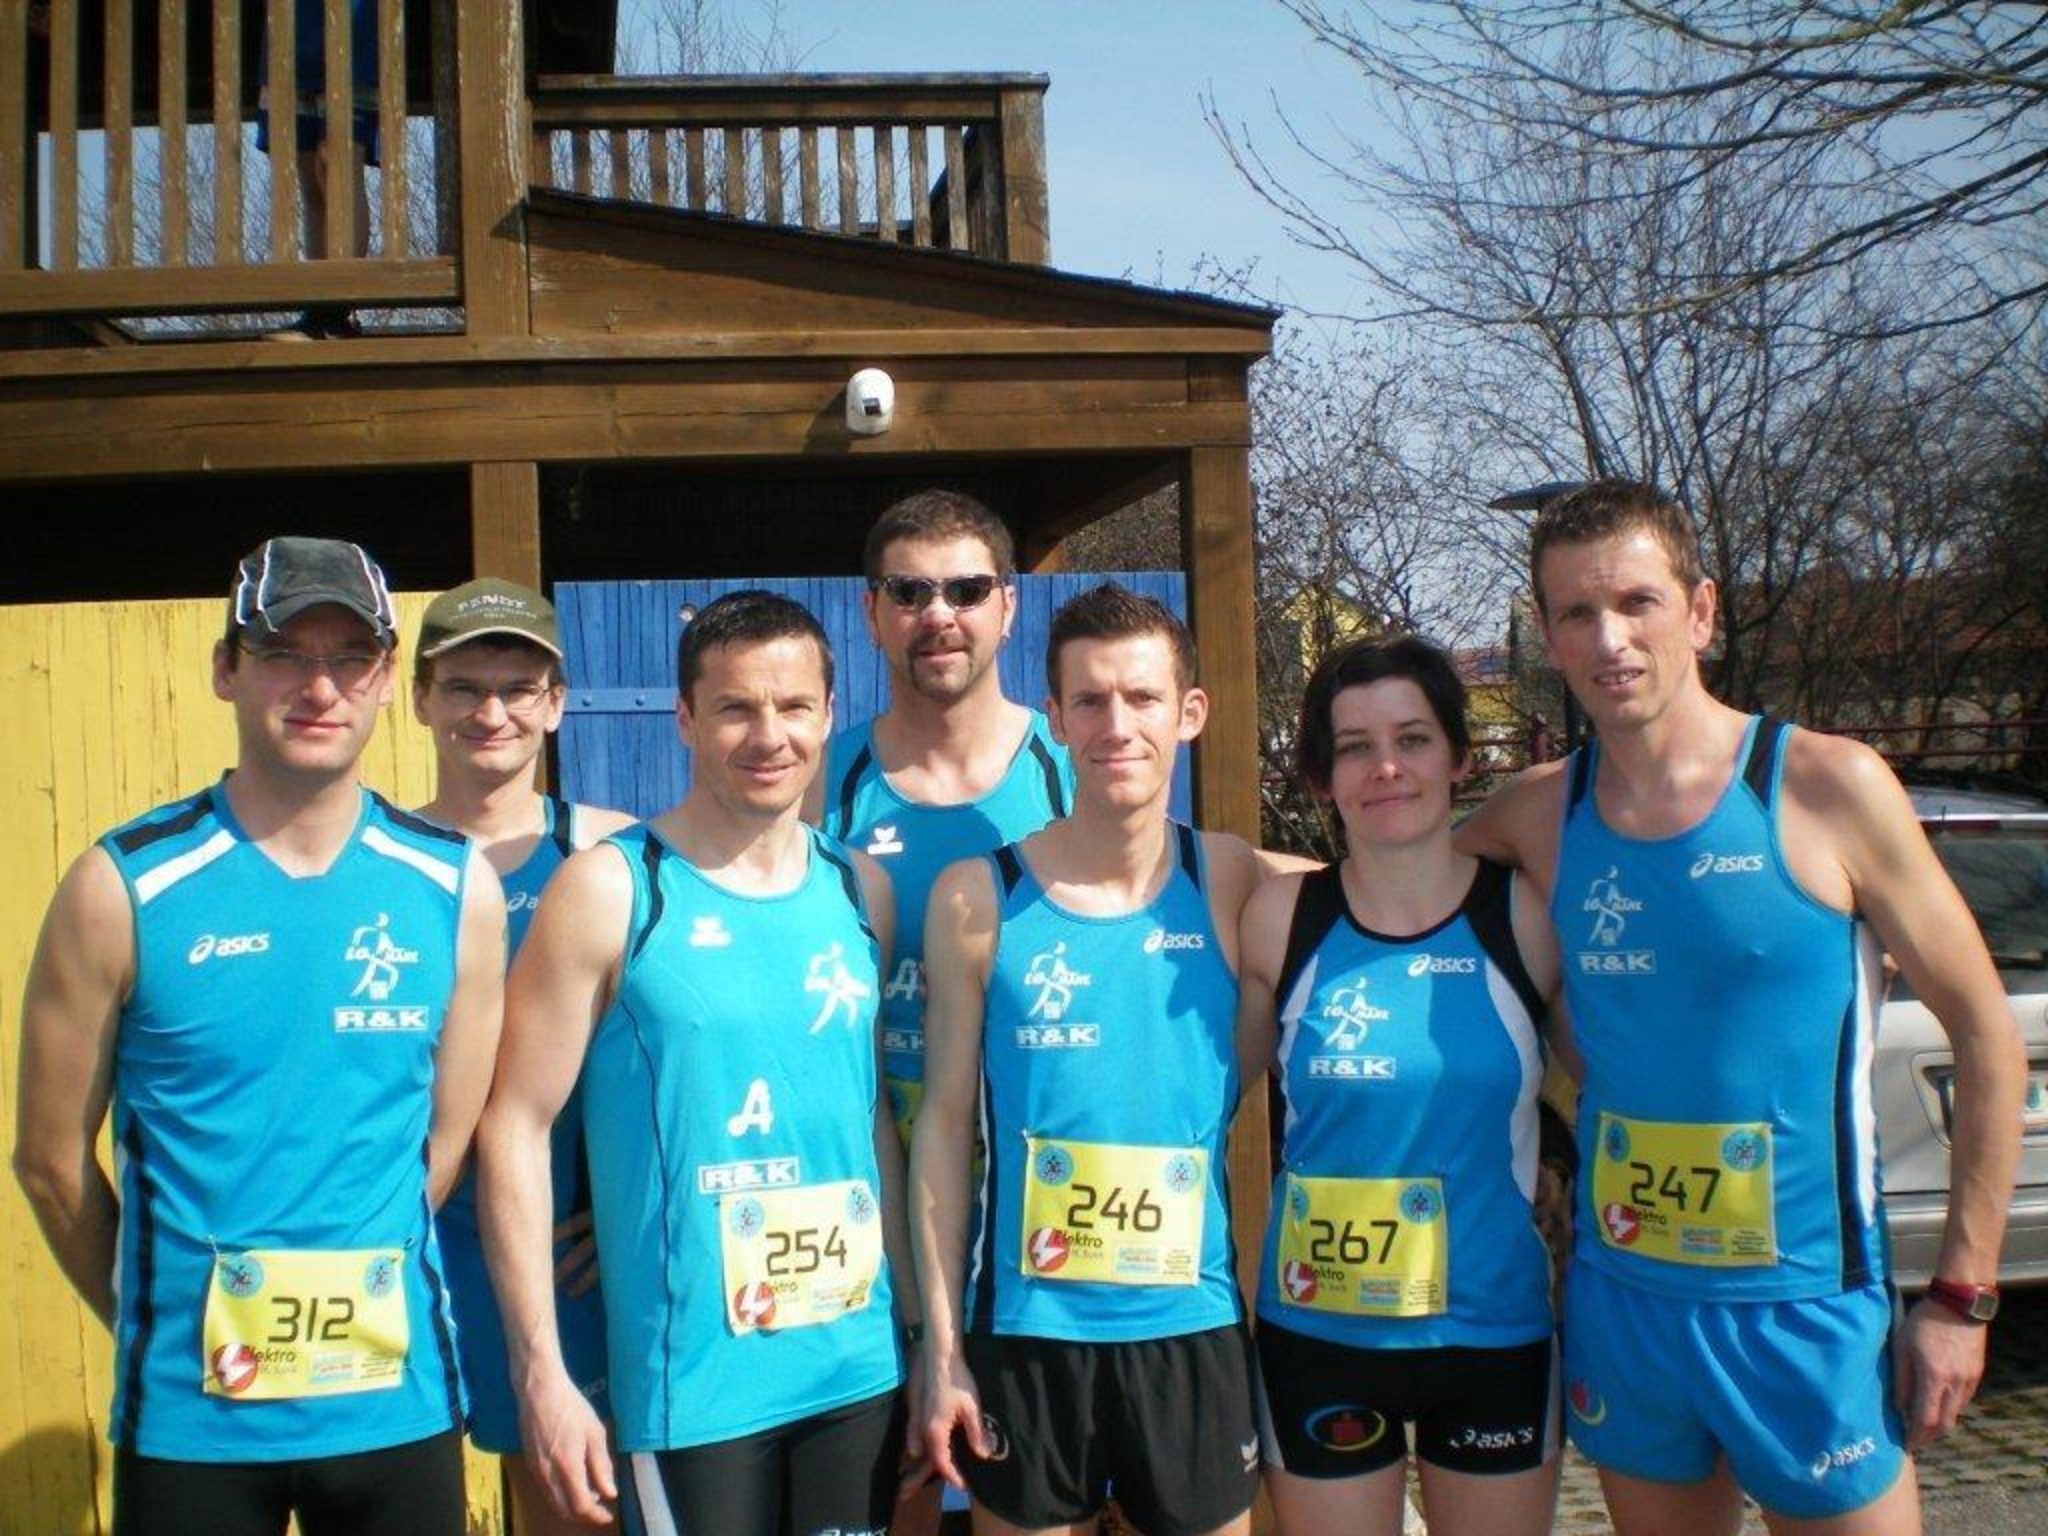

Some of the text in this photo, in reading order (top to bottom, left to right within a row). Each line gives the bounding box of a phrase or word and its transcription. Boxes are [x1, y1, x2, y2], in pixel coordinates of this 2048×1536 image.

[1579, 953, 1653, 971] R&K
[335, 1009, 426, 1028] R&K
[1017, 1027, 1097, 1045] R&K
[1310, 1059, 1391, 1076] R&K
[704, 1162, 795, 1190] R&K
[1629, 1161, 1721, 1213] 247
[1067, 1183, 1163, 1233] 246
[765, 1225, 847, 1277] 254
[1309, 1219, 1399, 1265] 267
[267, 1296, 355, 1344] 312
[1833, 1437, 1875, 1466] asics
